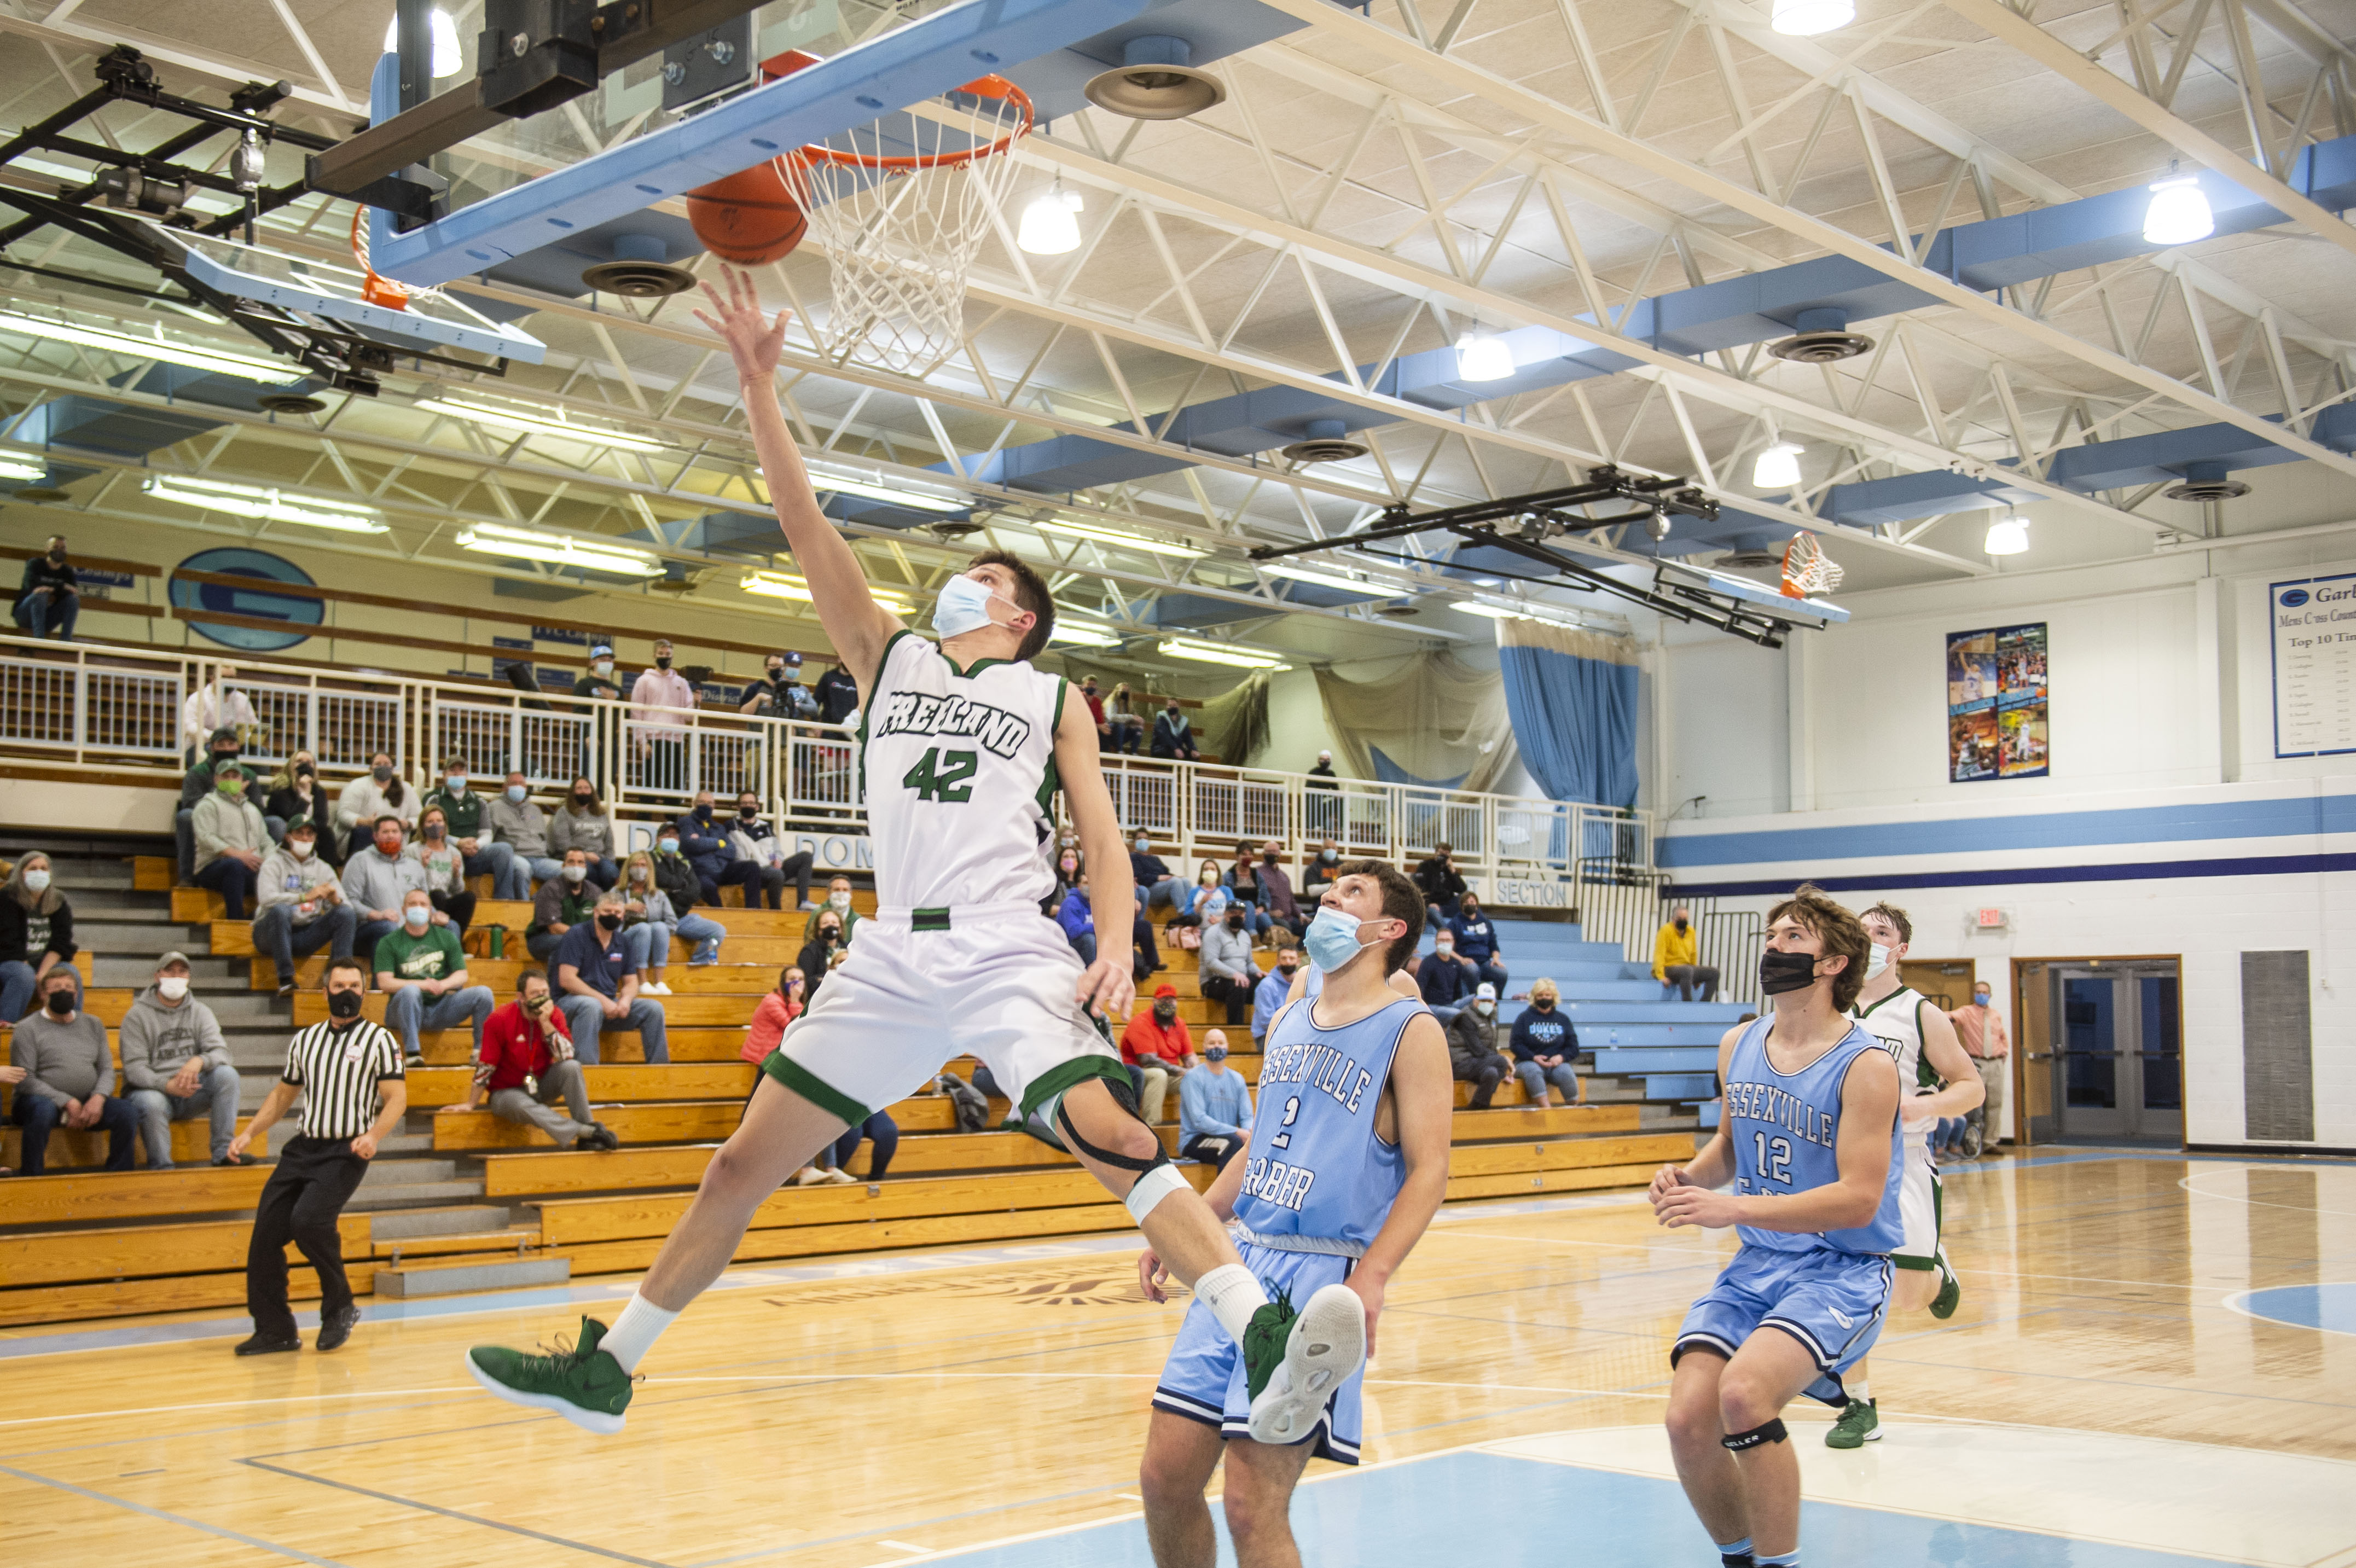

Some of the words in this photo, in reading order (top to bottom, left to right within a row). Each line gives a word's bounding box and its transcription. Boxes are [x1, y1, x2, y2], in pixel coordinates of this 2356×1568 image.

[2304, 612, 2328, 625] Coss
[2288, 637, 2313, 648] Top
[2317, 634, 2332, 644] 10
[876, 690, 1030, 760] FREELAND
[903, 747, 978, 803] 42
[1497, 879, 1567, 907] SECTION
[1260, 1043, 1372, 1115] SSEXVILLE
[1271, 1096, 1301, 1150] 2
[1754, 1130, 1792, 1186] 12
[762, 1282, 984, 1308] Family
[971, 1264, 1140, 1285] unrise
